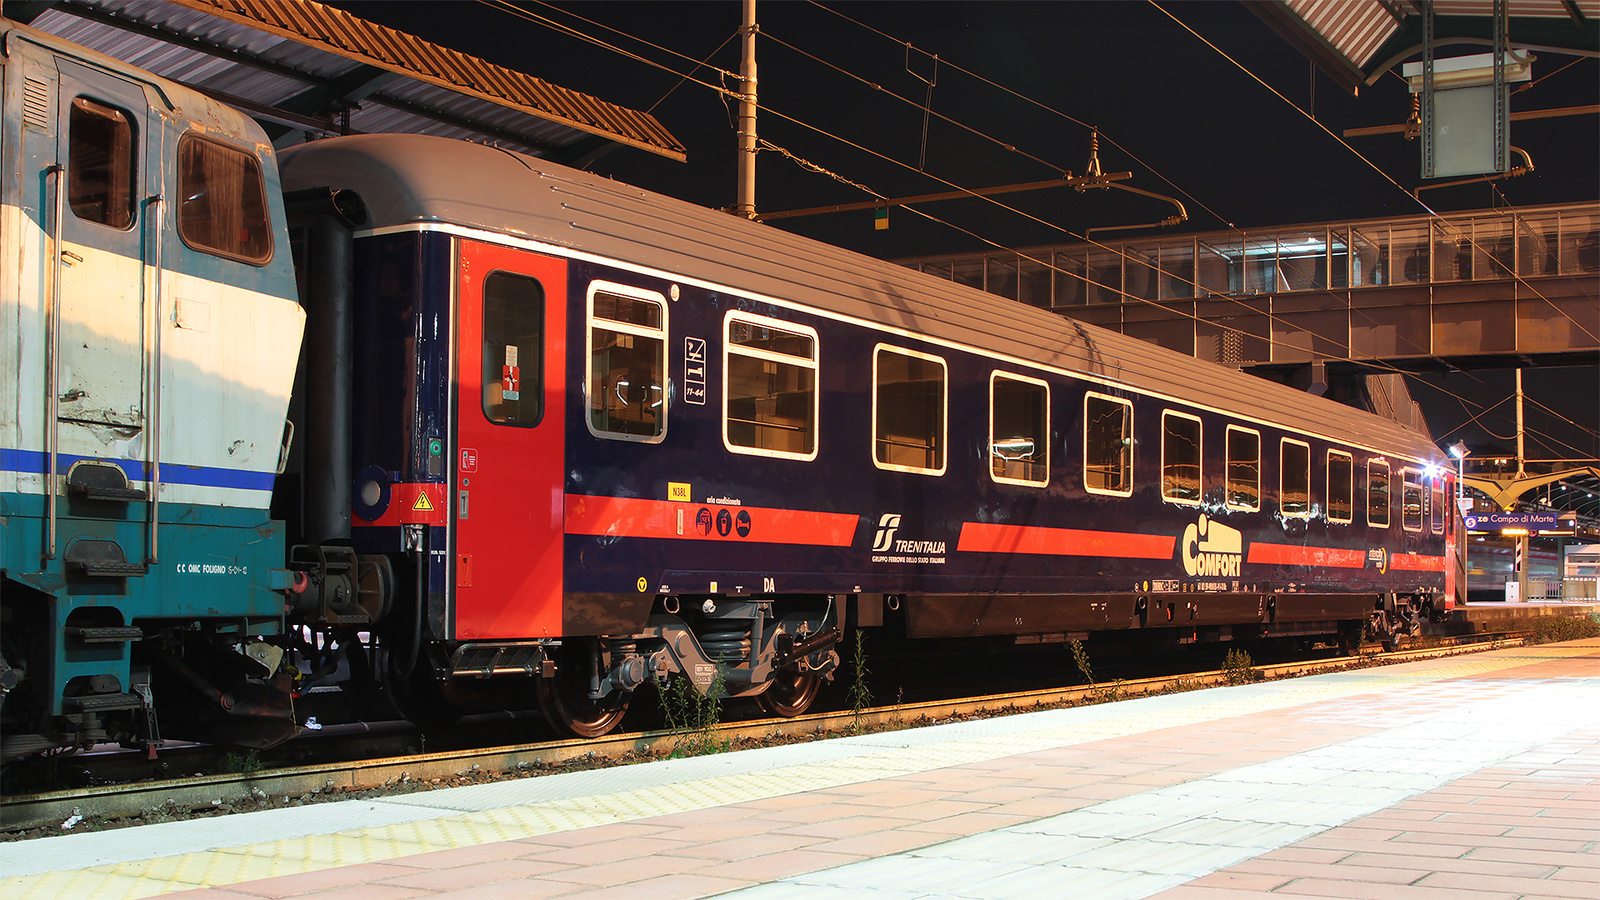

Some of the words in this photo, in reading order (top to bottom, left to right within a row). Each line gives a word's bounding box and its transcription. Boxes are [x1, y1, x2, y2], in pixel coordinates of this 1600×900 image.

[687, 387, 703, 397] 11-44
[1490, 514, 1519, 524] Campo
[1520, 514, 1529, 523] di
[1530, 514, 1554, 523] Marte
[895, 540, 946, 554] TRENITALIA
[1183, 522, 1242, 577] COMFORT
[202, 564, 226, 574] FOLIGNO
[763, 577, 776, 593] DA
